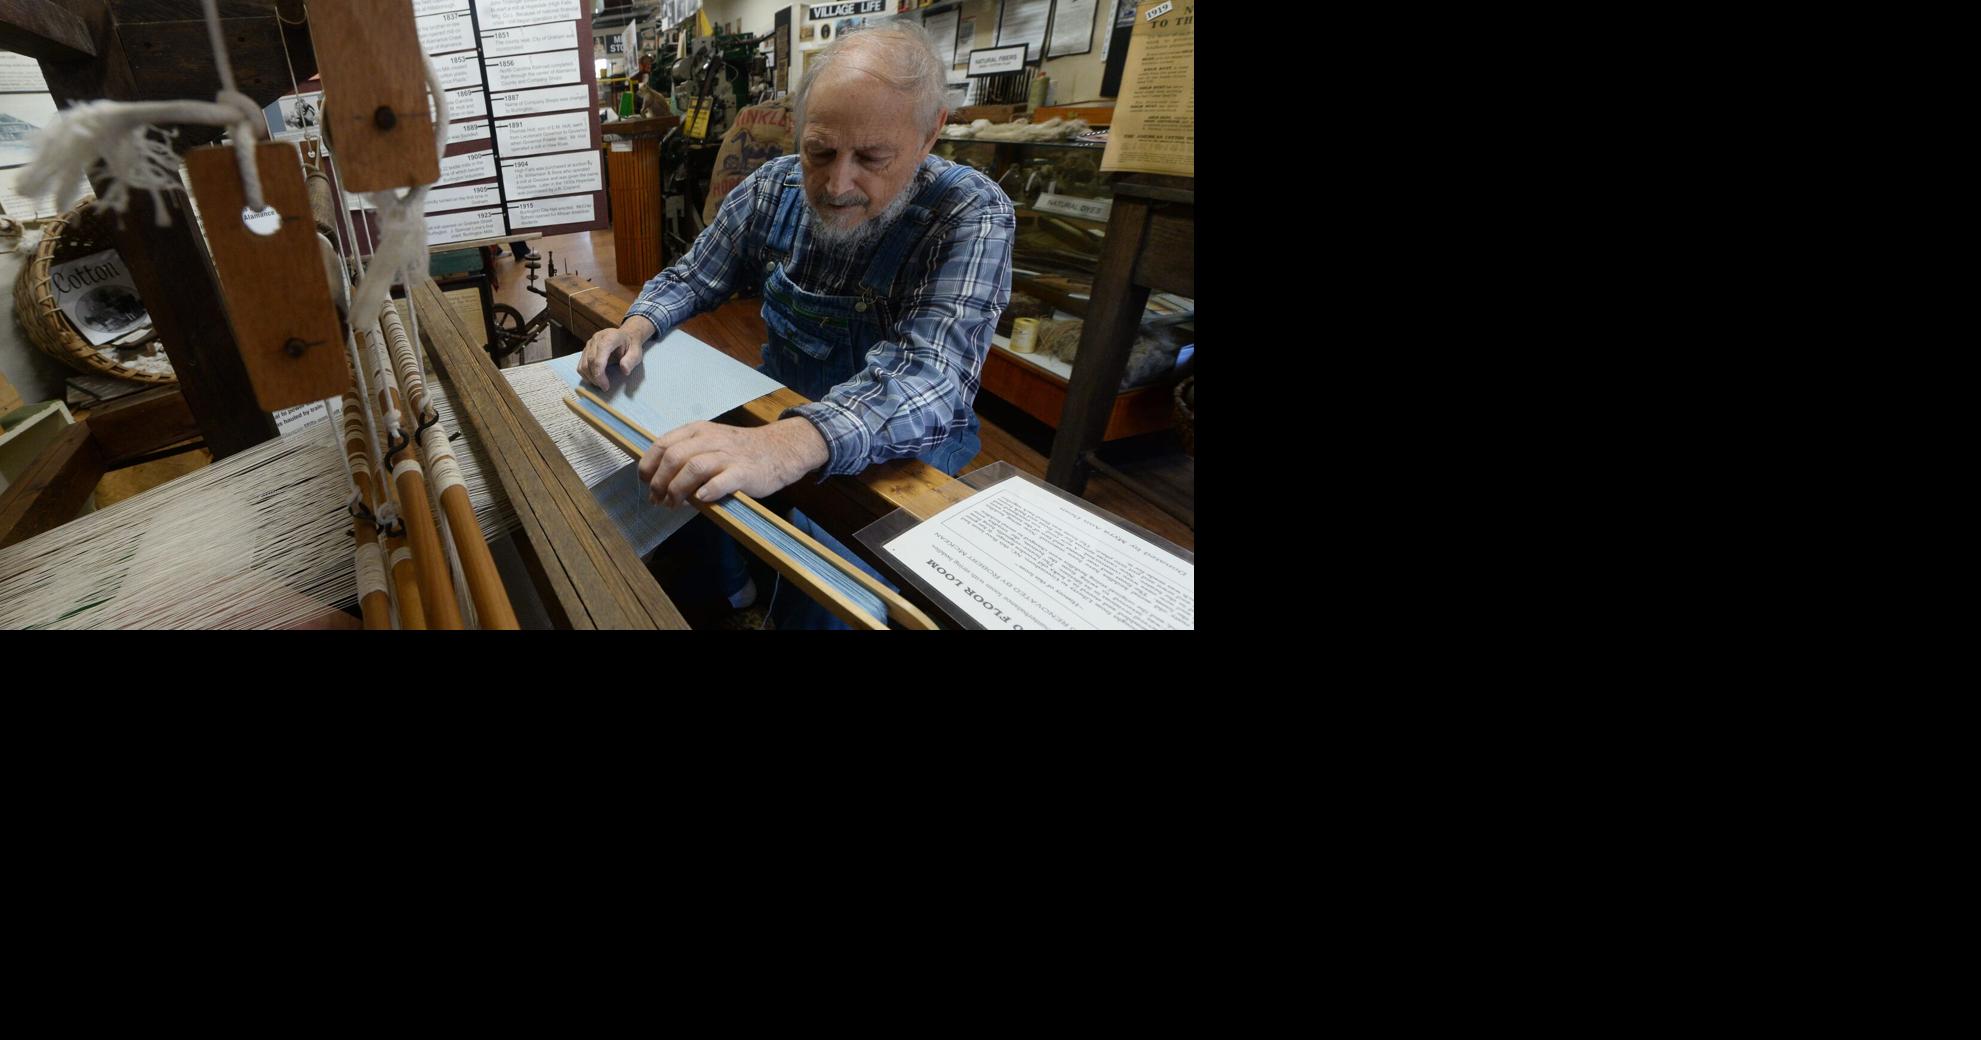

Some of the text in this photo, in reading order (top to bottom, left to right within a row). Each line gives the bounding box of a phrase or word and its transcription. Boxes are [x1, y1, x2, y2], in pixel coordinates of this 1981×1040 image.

[813, 0, 881, 19] VILLAGE LIFE
[1147, 4, 1169, 18] 1919
[443, 13, 458, 21] 1837
[1151, 19, 1169, 29] TO
[450, 56, 466, 64] 1853
[463, 124, 478, 132] 1889
[244, 211, 275, 220] Alamance
[51, 258, 121, 294] Cotton
[964, 554, 1002, 579] ROBERT
[924, 558, 1012, 624] FLOOR LOOM
